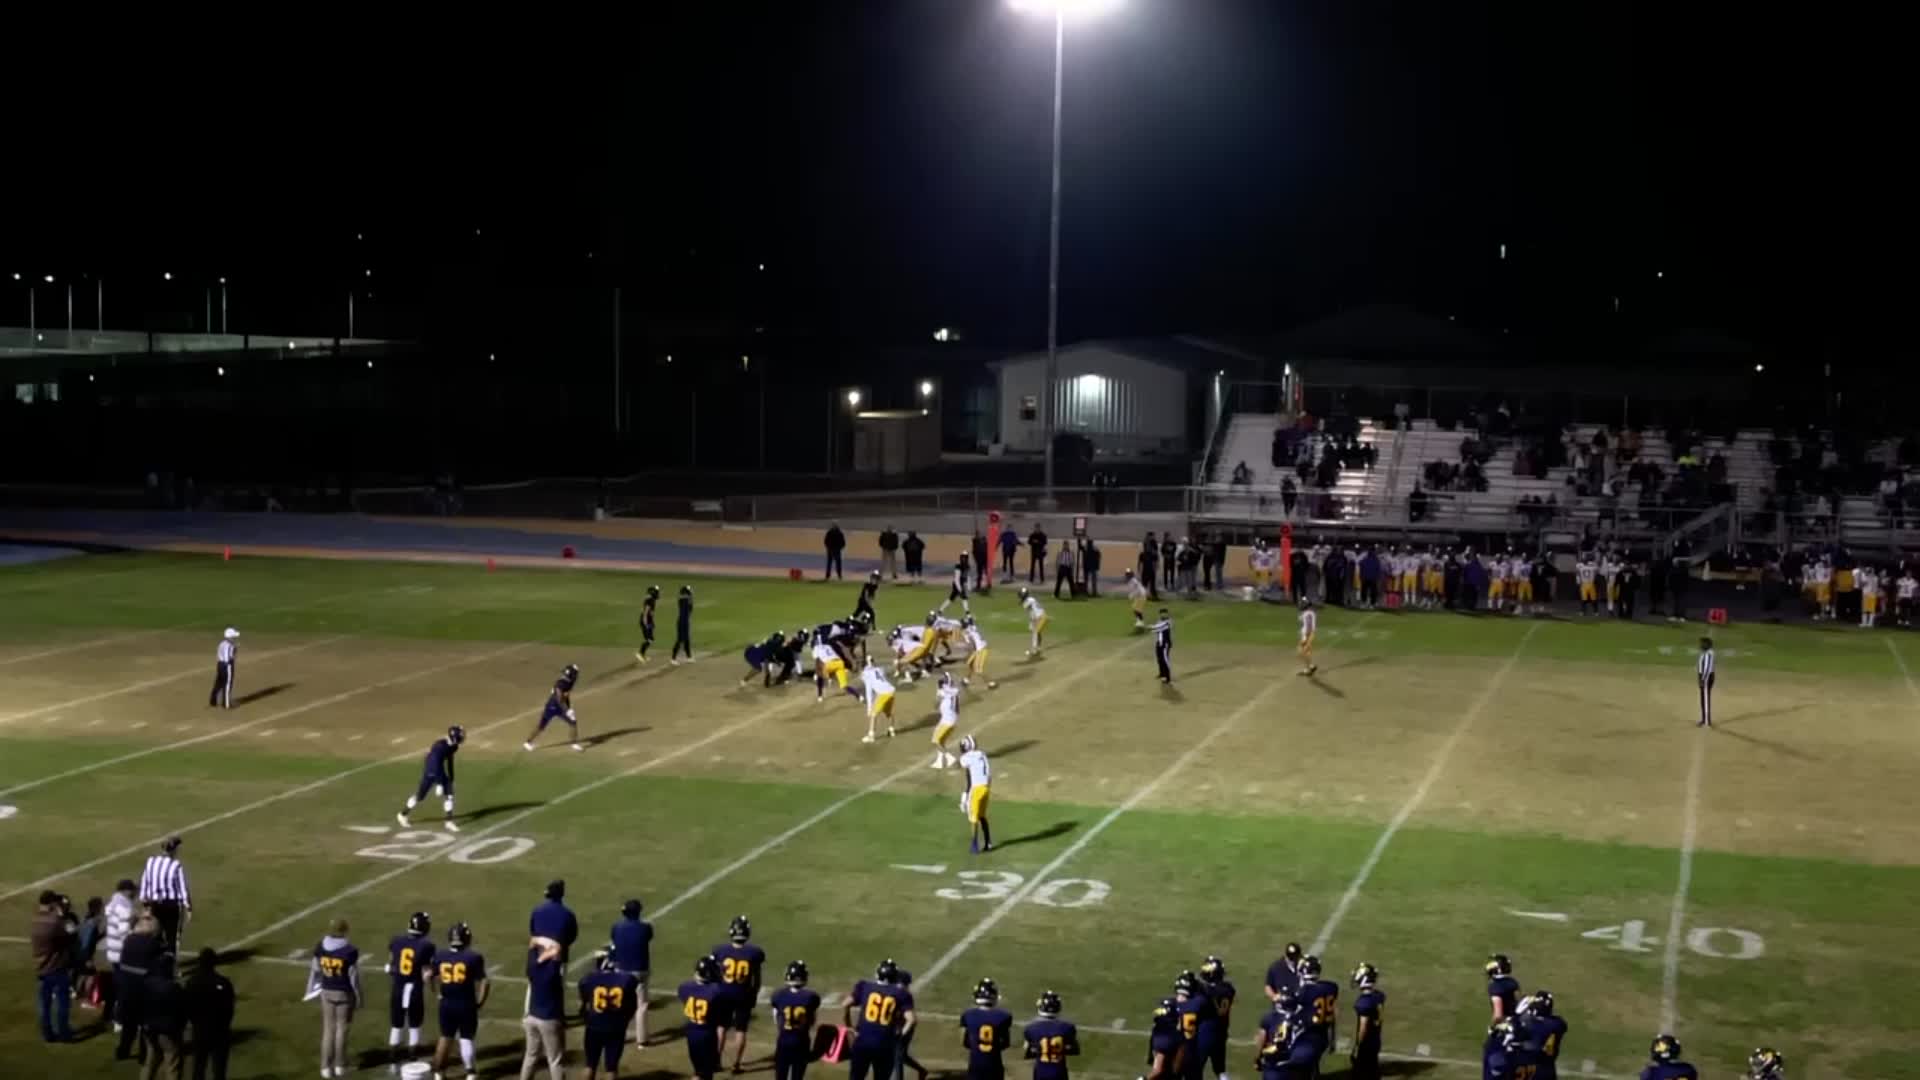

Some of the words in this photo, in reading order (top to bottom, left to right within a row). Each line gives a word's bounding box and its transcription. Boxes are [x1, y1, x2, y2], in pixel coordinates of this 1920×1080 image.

[353, 830, 537, 865] 20
[934, 870, 1111, 909] 30
[1579, 920, 1765, 961] 40
[399, 947, 415, 976] 6
[683, 995, 708, 1026] 42
[864, 991, 897, 1026] 60
[978, 1024, 994, 1053] 9
